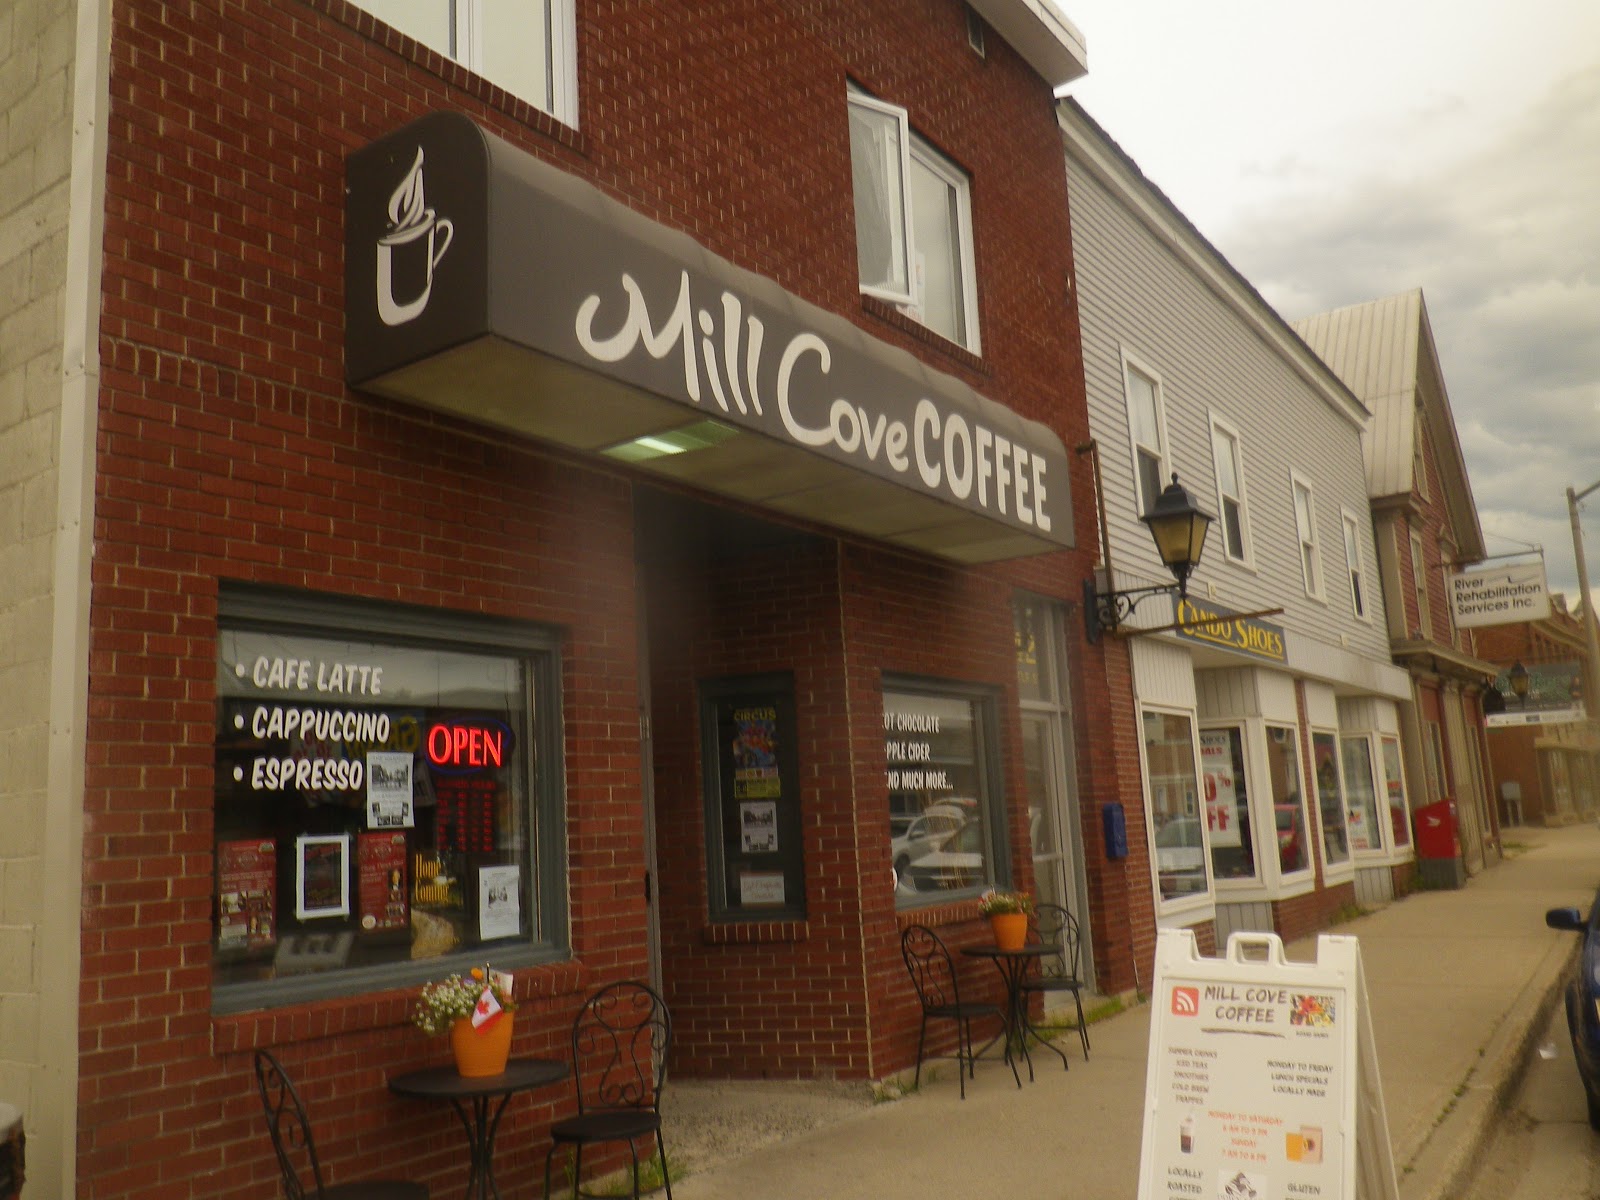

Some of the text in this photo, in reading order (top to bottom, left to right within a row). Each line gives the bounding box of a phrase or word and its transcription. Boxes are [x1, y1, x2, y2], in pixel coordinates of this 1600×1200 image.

[574, 269, 1052, 533] Mill Cove COFFEE
[1454, 579, 1484, 591] River
[1456, 583, 1541, 603] Rehabilitation
[1458, 597, 1536, 616] Services Inc.
[253, 655, 384, 696] CAFE LATTE
[733, 706, 777, 721] CIRCUS
[882, 711, 940, 734] OT CHOCOLATE
[251, 706, 391, 744] CAPPUCCINO
[427, 723, 503, 768] OPEN
[884, 741, 932, 762] PPLE CIDER
[251, 757, 364, 791] ESPRESSO
[884, 770, 954, 791] ND MUCH MORE...
[1204, 985, 1288, 1005] MILL COVE
[1215, 1005, 1275, 1024] COFFEE
[1267, 1060, 1333, 1074] MONDAY TO FRIDAY
[1271, 1072, 1329, 1086] LUNCH SPECIALS
[1272, 1085, 1326, 1098] LOCALLY MADE
[1167, 1166, 1204, 1179] LOCALLY
[1167, 1180, 1203, 1194] ROASTED
[1287, 1182, 1321, 1196] GLUTEN
